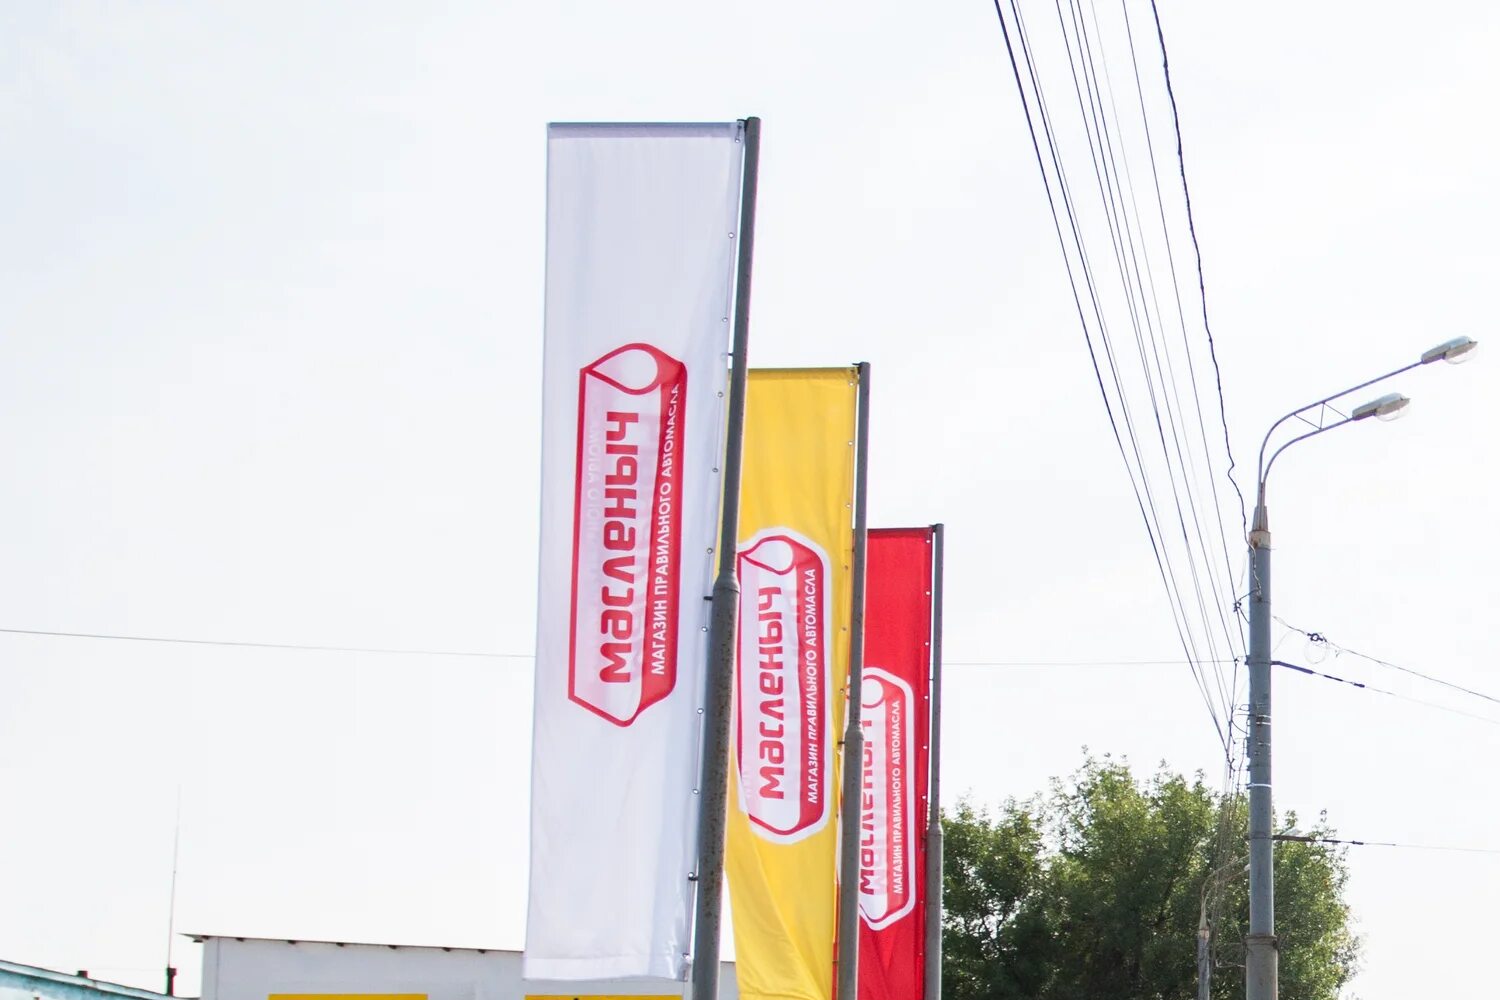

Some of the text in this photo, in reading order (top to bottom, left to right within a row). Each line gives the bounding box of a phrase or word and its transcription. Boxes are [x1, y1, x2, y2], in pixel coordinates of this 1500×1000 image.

[650, 383, 680, 676] МАГАЗИН ПРАВИЛЬНОГО АВТОМАСЛА
[804, 568, 819, 804] МАГАЗИН ПРАВИЛЬНОГО АВТОМАСЛА
[891, 700, 903, 894] МАГАЗИН ПРАВИЛЬНОГО АВТОМАСЛА
